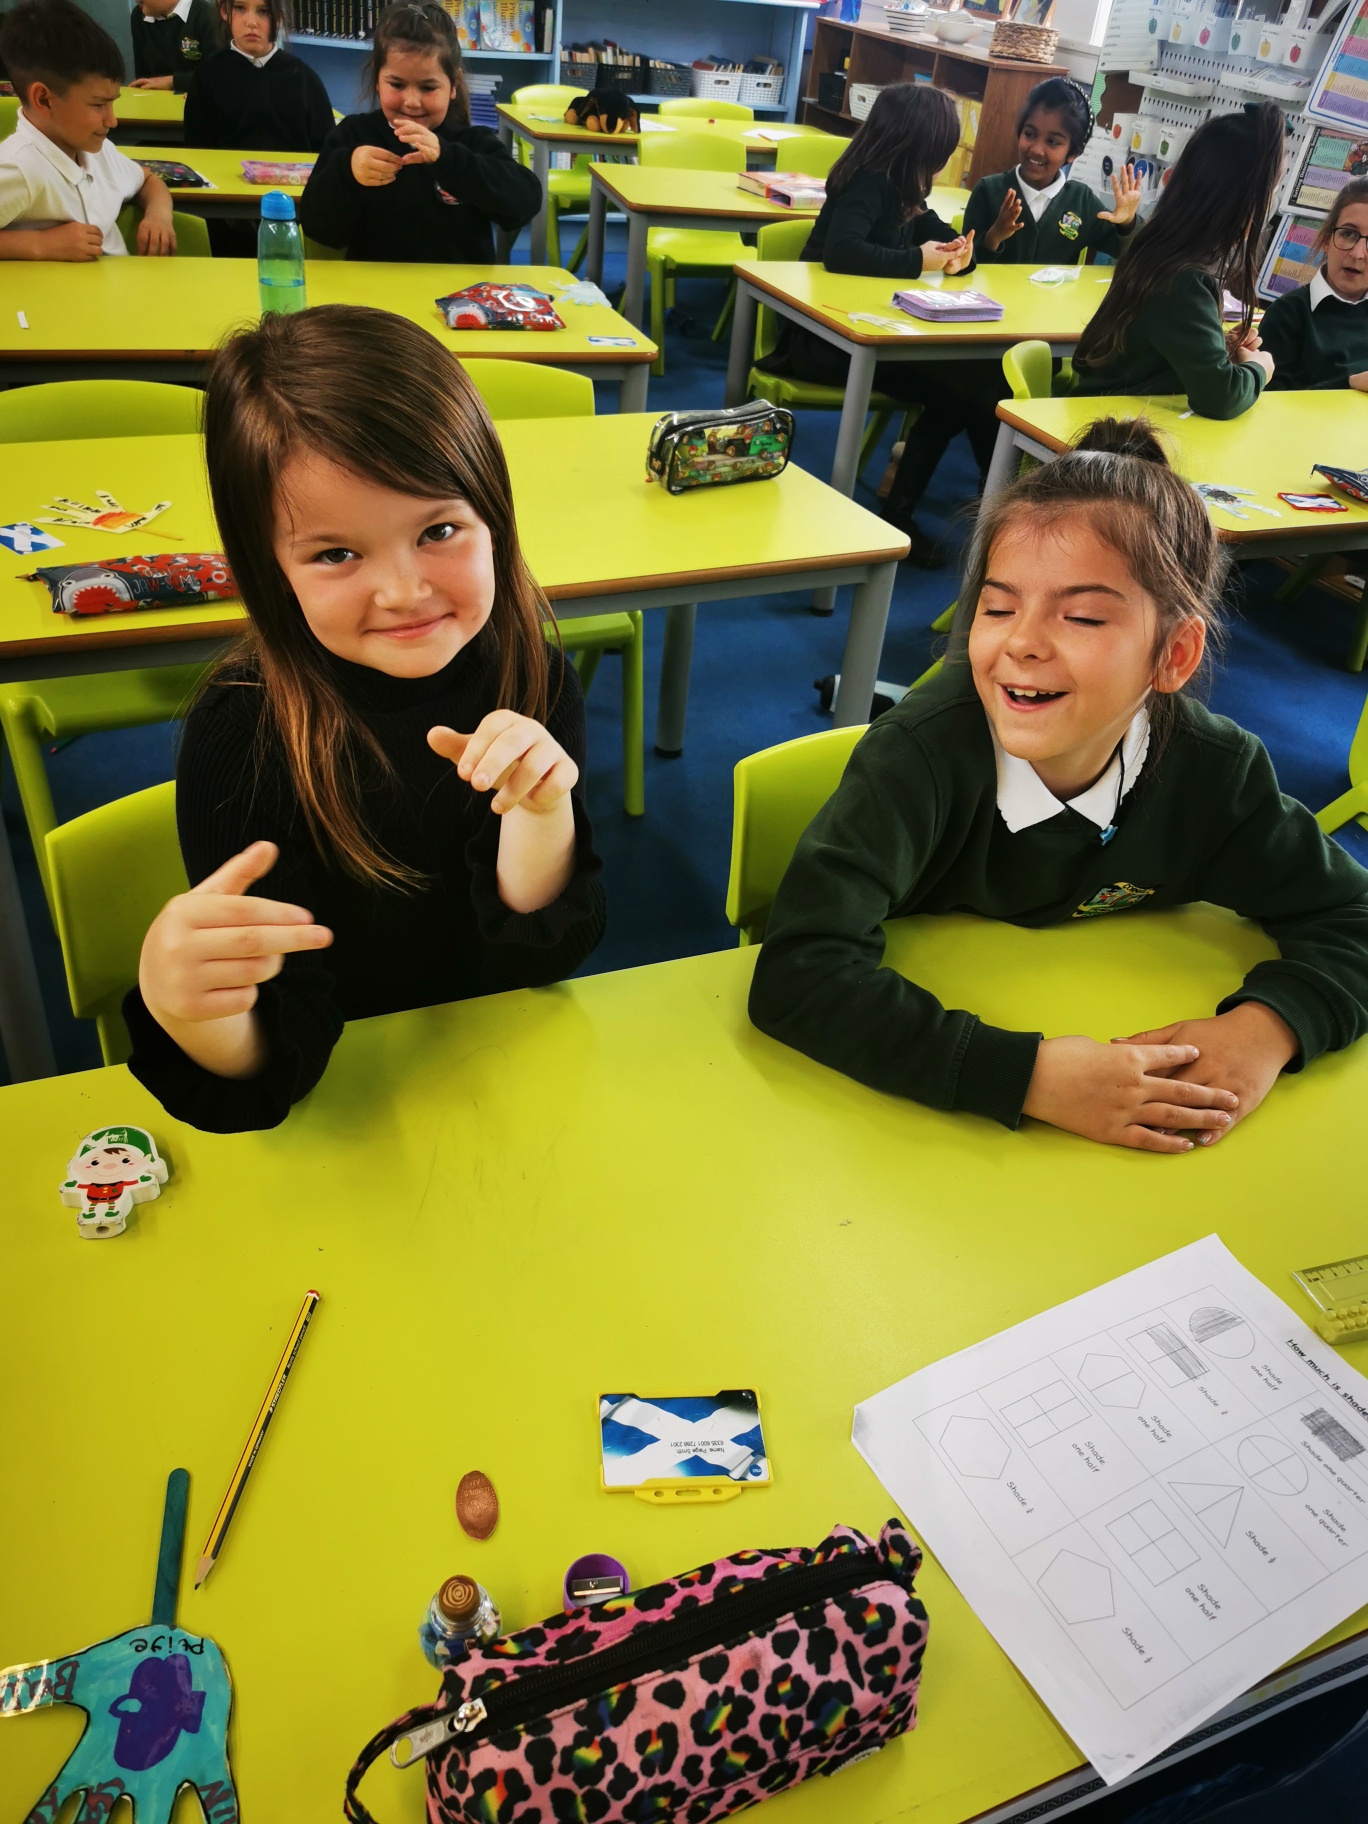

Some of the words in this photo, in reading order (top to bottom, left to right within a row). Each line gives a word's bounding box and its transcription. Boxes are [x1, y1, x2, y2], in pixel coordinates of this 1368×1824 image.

[508, 2, 517, 37] Primary
[1292, 178, 1303, 199] Setting
[1300, 147, 1314, 178] Description
[1310, 128, 1321, 147] Senses
[1250, 1365, 1264, 1378] one
[1262, 1377, 1280, 1391] half
[1261, 1364, 1283, 1385] Shade
[1286, 1338, 1307, 1357] How
[1306, 1359, 1330, 1381] much
[1331, 1382, 1341, 1391] is
[1341, 1392, 1368, 1420] shade
[271, 1373, 287, 1407] STAEDTLER
[1198, 1386, 1219, 1407] Shade
[1138, 1415, 1151, 1429] one
[1150, 1428, 1167, 1445] half
[1150, 1415, 1172, 1438] Shade
[1072, 1442, 1085, 1457] one
[1084, 1456, 1100, 1473] half
[1084, 1440, 1106, 1466] Shade
[1300, 1440, 1323, 1462] Shade
[1322, 1463, 1336, 1476] one
[1336, 1476, 1366, 1504] quarter
[1006, 1481, 1028, 1508] Shade
[1304, 1504, 1318, 1518] one
[1318, 1518, 1348, 1548] quarter
[1322, 1508, 1346, 1532] Shade
[1245, 1530, 1269, 1556] Shade
[1184, 1587, 1200, 1603] one
[1198, 1602, 1218, 1621] half
[1197, 1583, 1221, 1610] Shade
[1122, 1626, 1146, 1655] Shade
